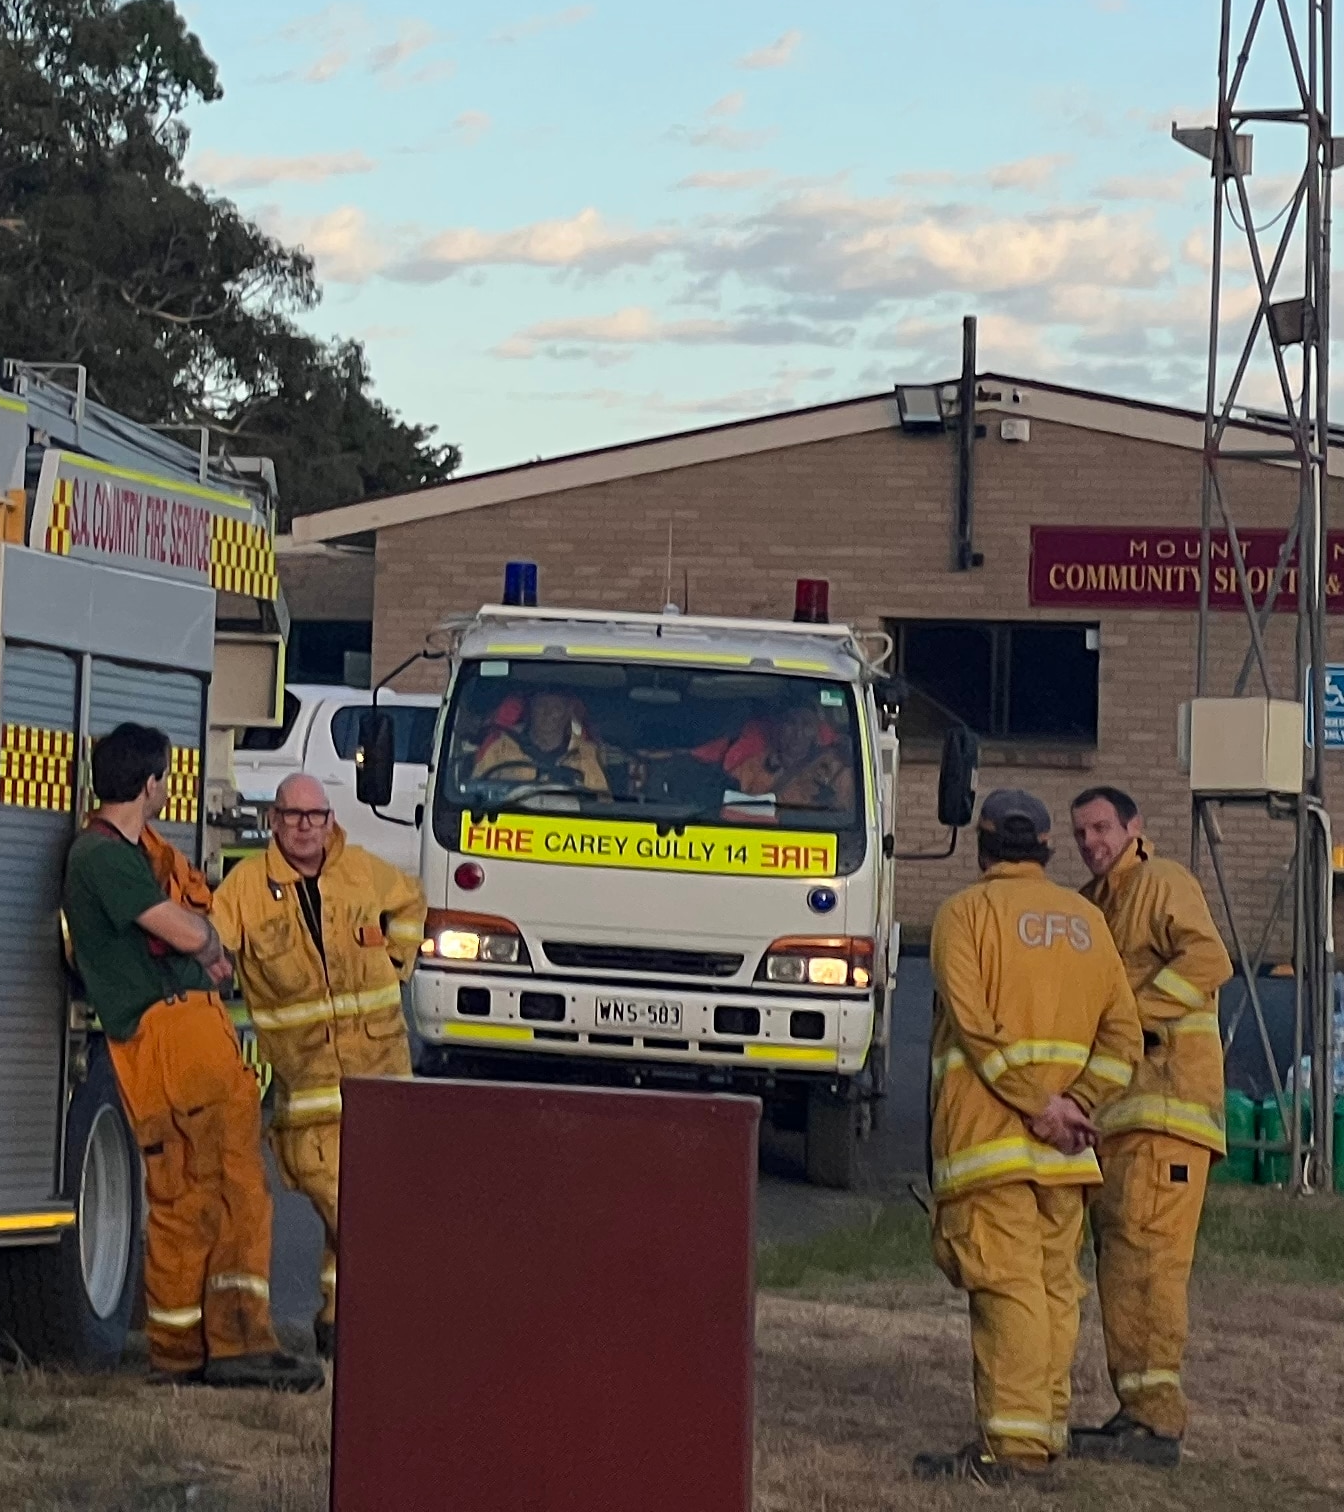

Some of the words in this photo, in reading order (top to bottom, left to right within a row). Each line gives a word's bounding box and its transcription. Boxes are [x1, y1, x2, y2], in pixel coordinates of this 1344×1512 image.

[93, 482, 142, 557] COUNTRY
[144, 495, 168, 563] FIRE
[169, 500, 210, 572] SERVICE
[1129, 539, 1252, 561] MOUNT
[1049, 563, 1201, 594] COMMUNITY
[466, 825, 534, 853] FIRE
[544, 831, 629, 857] CAREY
[636, 836, 715, 863] GULLY
[724, 843, 748, 866] 14
[1018, 912, 1092, 953] CFS
